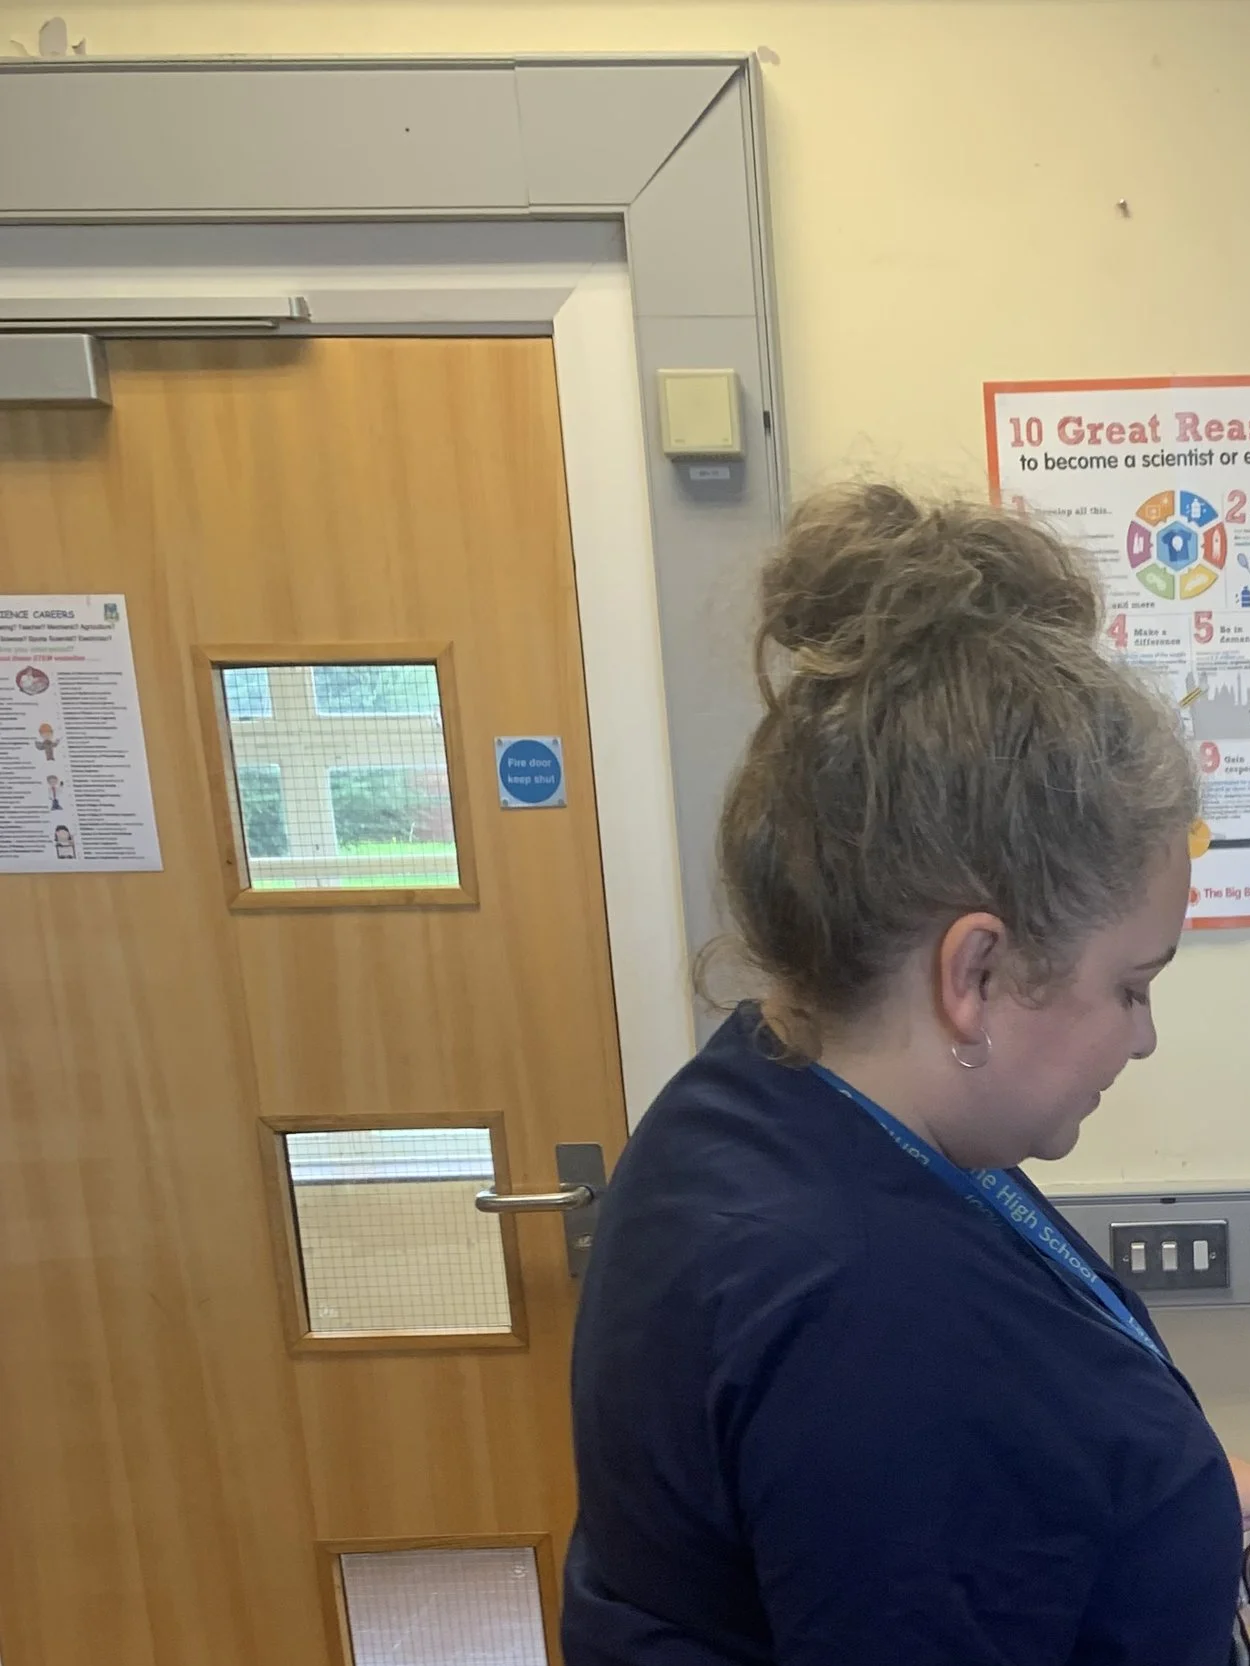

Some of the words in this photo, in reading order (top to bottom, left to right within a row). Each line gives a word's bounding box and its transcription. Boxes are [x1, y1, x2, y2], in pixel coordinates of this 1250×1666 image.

[1009, 416, 1043, 448] 10
[1057, 412, 1161, 446] Great
[1020, 454, 1038, 471] to
[1045, 452, 1118, 470] become
[1125, 455, 1135, 468] a
[1142, 448, 1214, 467] scientist
[1220, 451, 1238, 465] or
[1226, 489, 1247, 524] 2
[33, 610, 75, 619] CAREERS
[1106, 613, 1128, 649] 4
[1193, 610, 1214, 644] 5
[508, 758, 526, 768] Fire
[529, 758, 552, 767] door
[1200, 741, 1220, 774] 9
[508, 774, 531, 786] keep
[534, 774, 555, 784] shut
[1204, 888, 1223, 898] The
[1225, 888, 1241, 899] Big
[996, 1184, 1039, 1229] High
[1039, 1226, 1098, 1283] School
